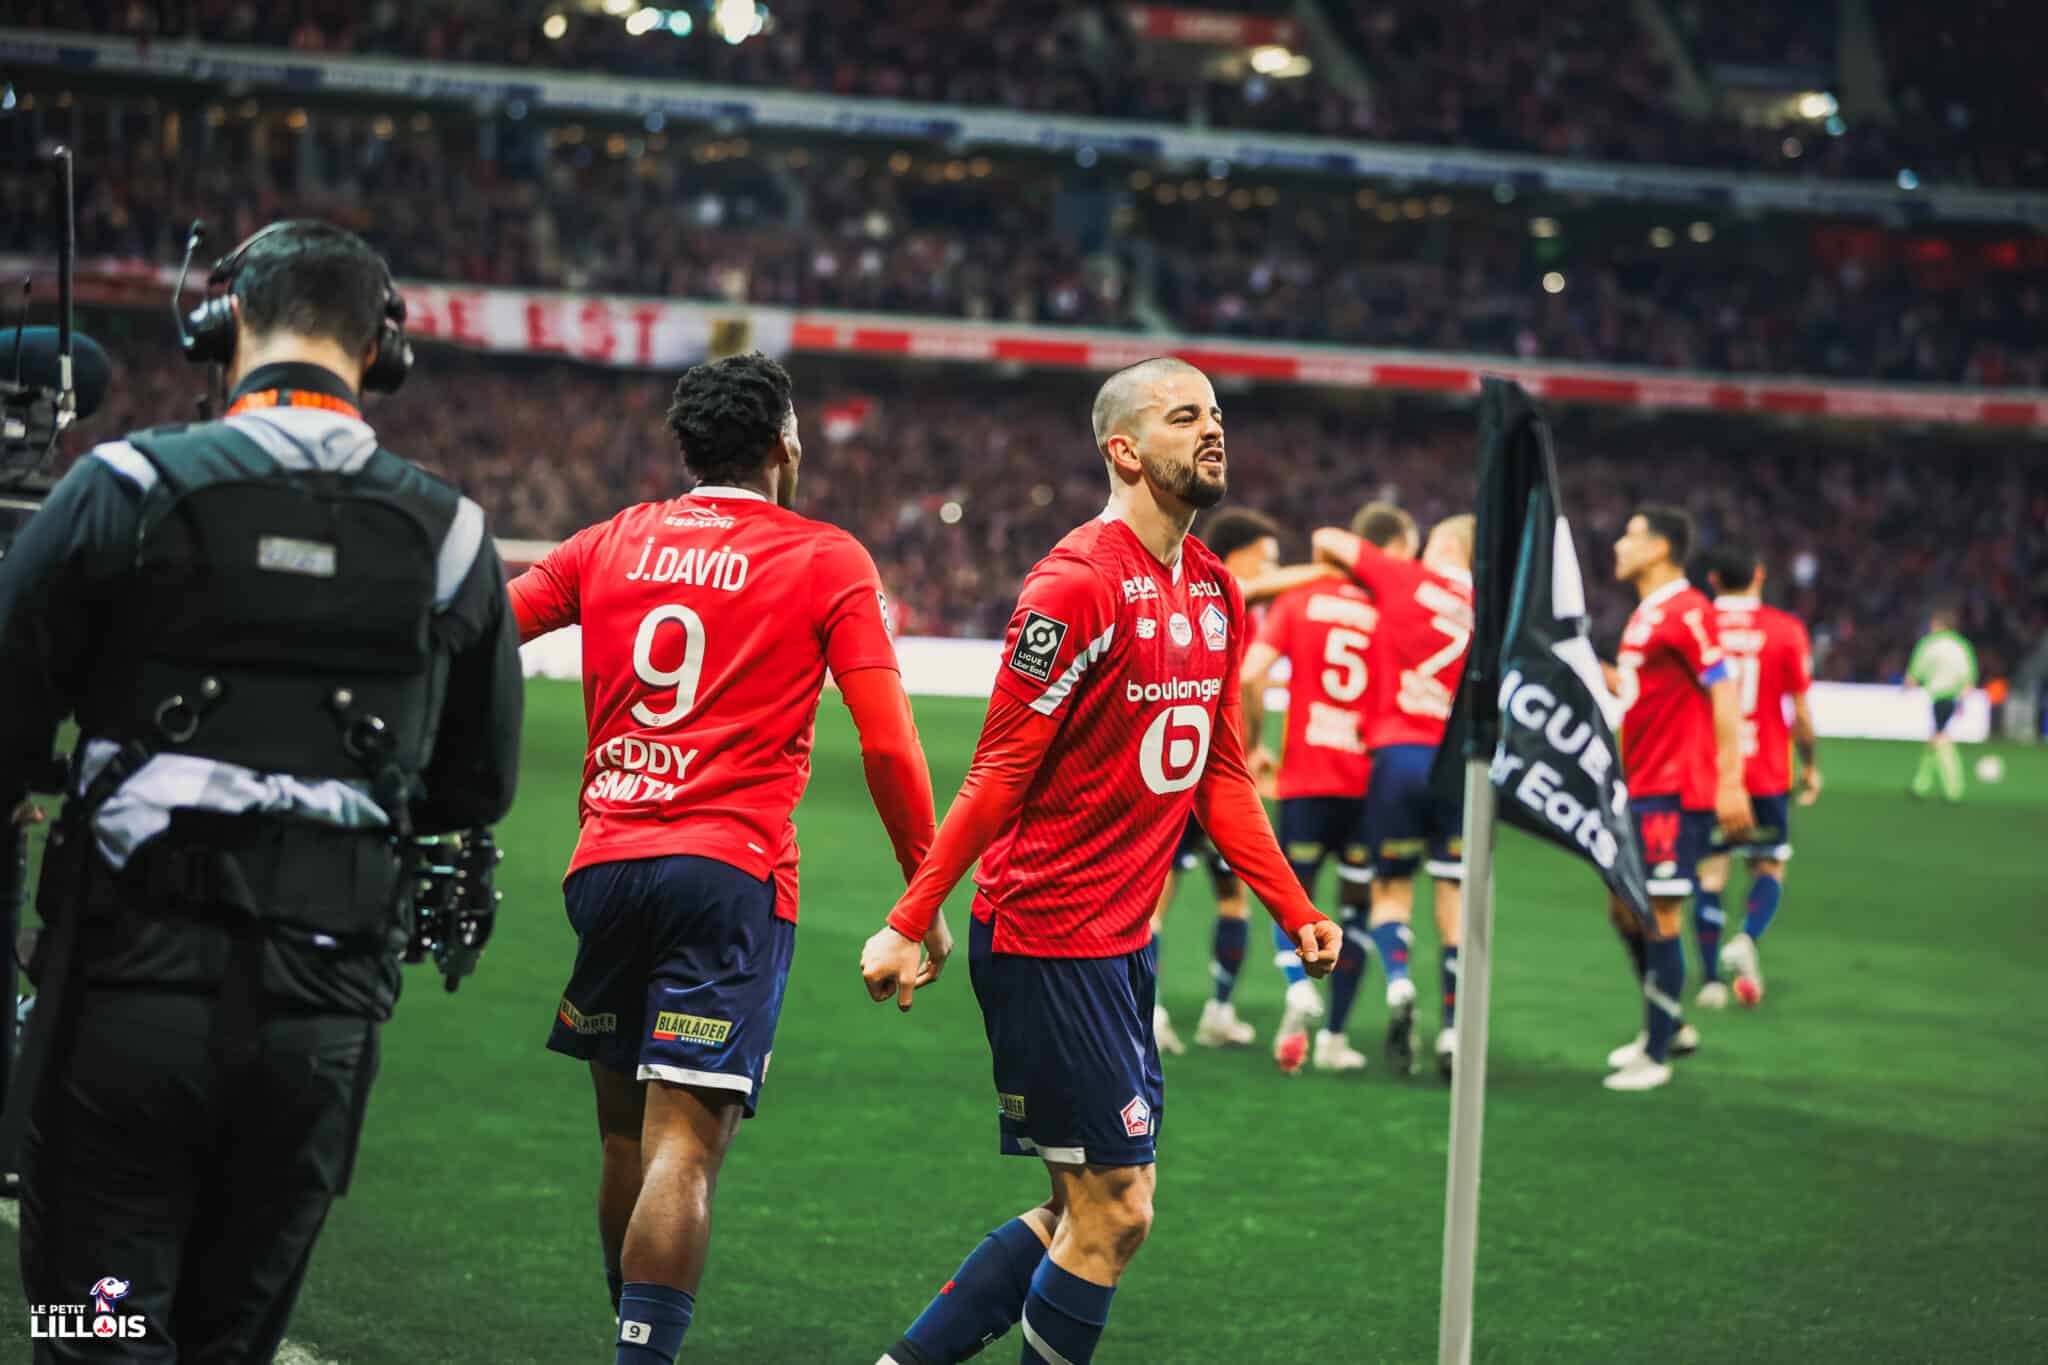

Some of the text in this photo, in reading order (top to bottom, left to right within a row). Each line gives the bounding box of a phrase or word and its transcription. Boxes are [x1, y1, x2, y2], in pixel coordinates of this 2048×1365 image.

[631, 604, 706, 727] 9
[1018, 651, 1043, 666] LIGUE
[1322, 627, 1371, 702] 5
[1415, 613, 1472, 678] 7
[1127, 676, 1222, 702] boulange
[595, 737, 699, 779] TEDDY
[629, 1325, 641, 1338] 9
